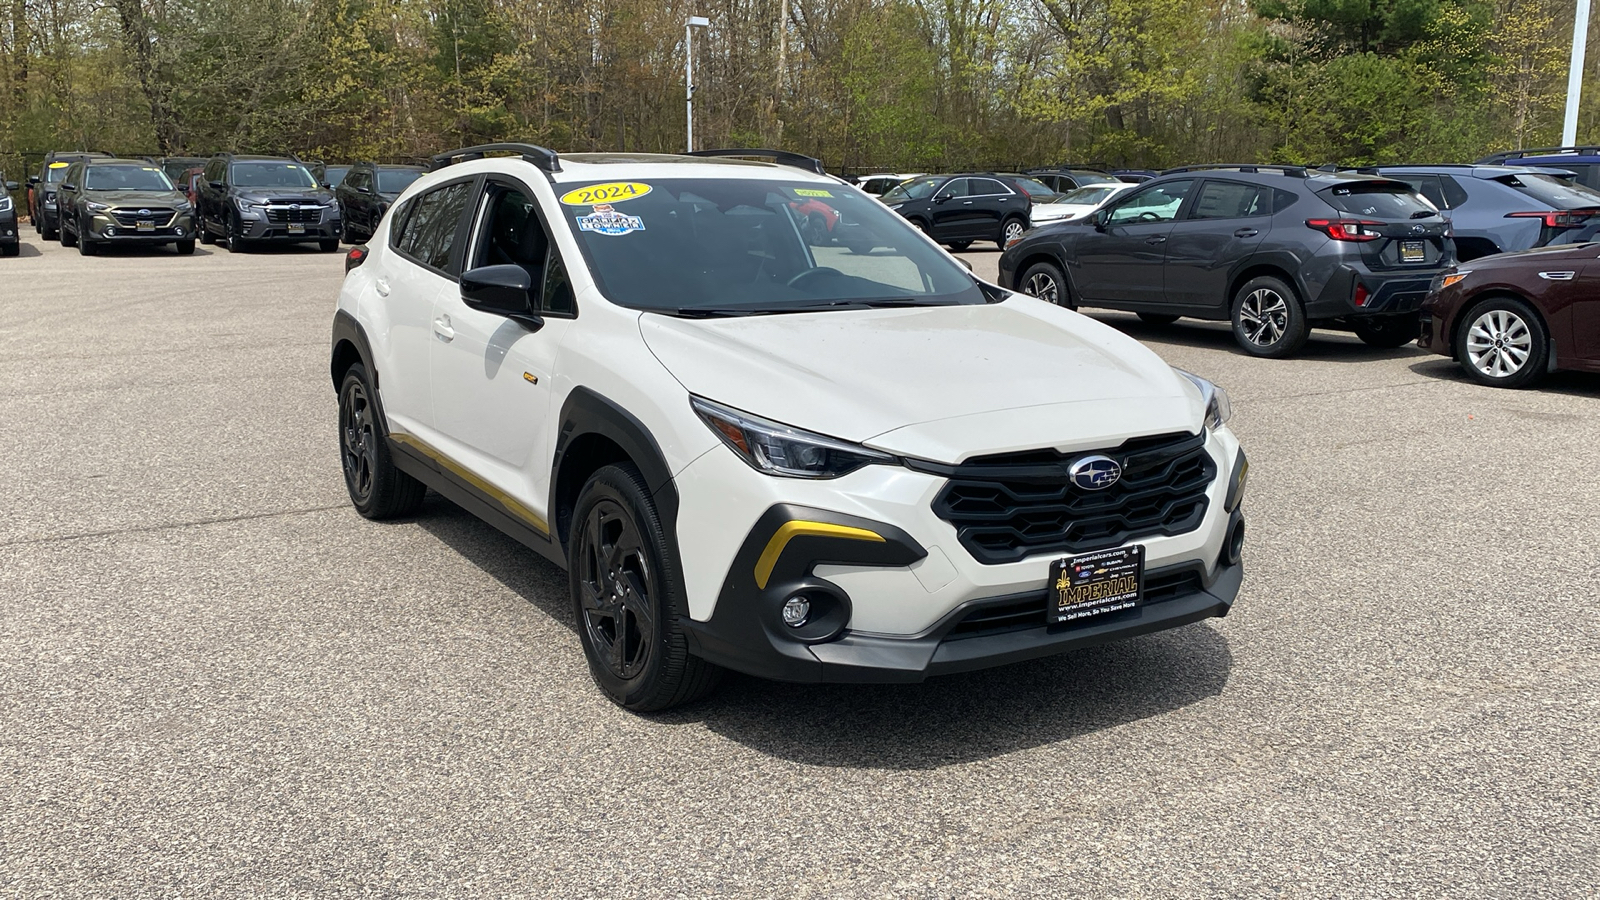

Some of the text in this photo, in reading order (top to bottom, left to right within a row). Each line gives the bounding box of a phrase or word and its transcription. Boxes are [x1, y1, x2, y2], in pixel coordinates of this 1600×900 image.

[578, 184, 639, 203] 2024
[1072, 550, 1126, 564] Imperialcars.com
[1109, 563, 1138, 572] CHEVROLET
[1058, 575, 1138, 606] IMPERIAL
[1058, 592, 1137, 612] www.imperialcars.com
[1067, 612, 1077, 620] Sell
[1078, 610, 1092, 619] More,
[1100, 606, 1110, 614] You
[1123, 601, 1136, 609] More
